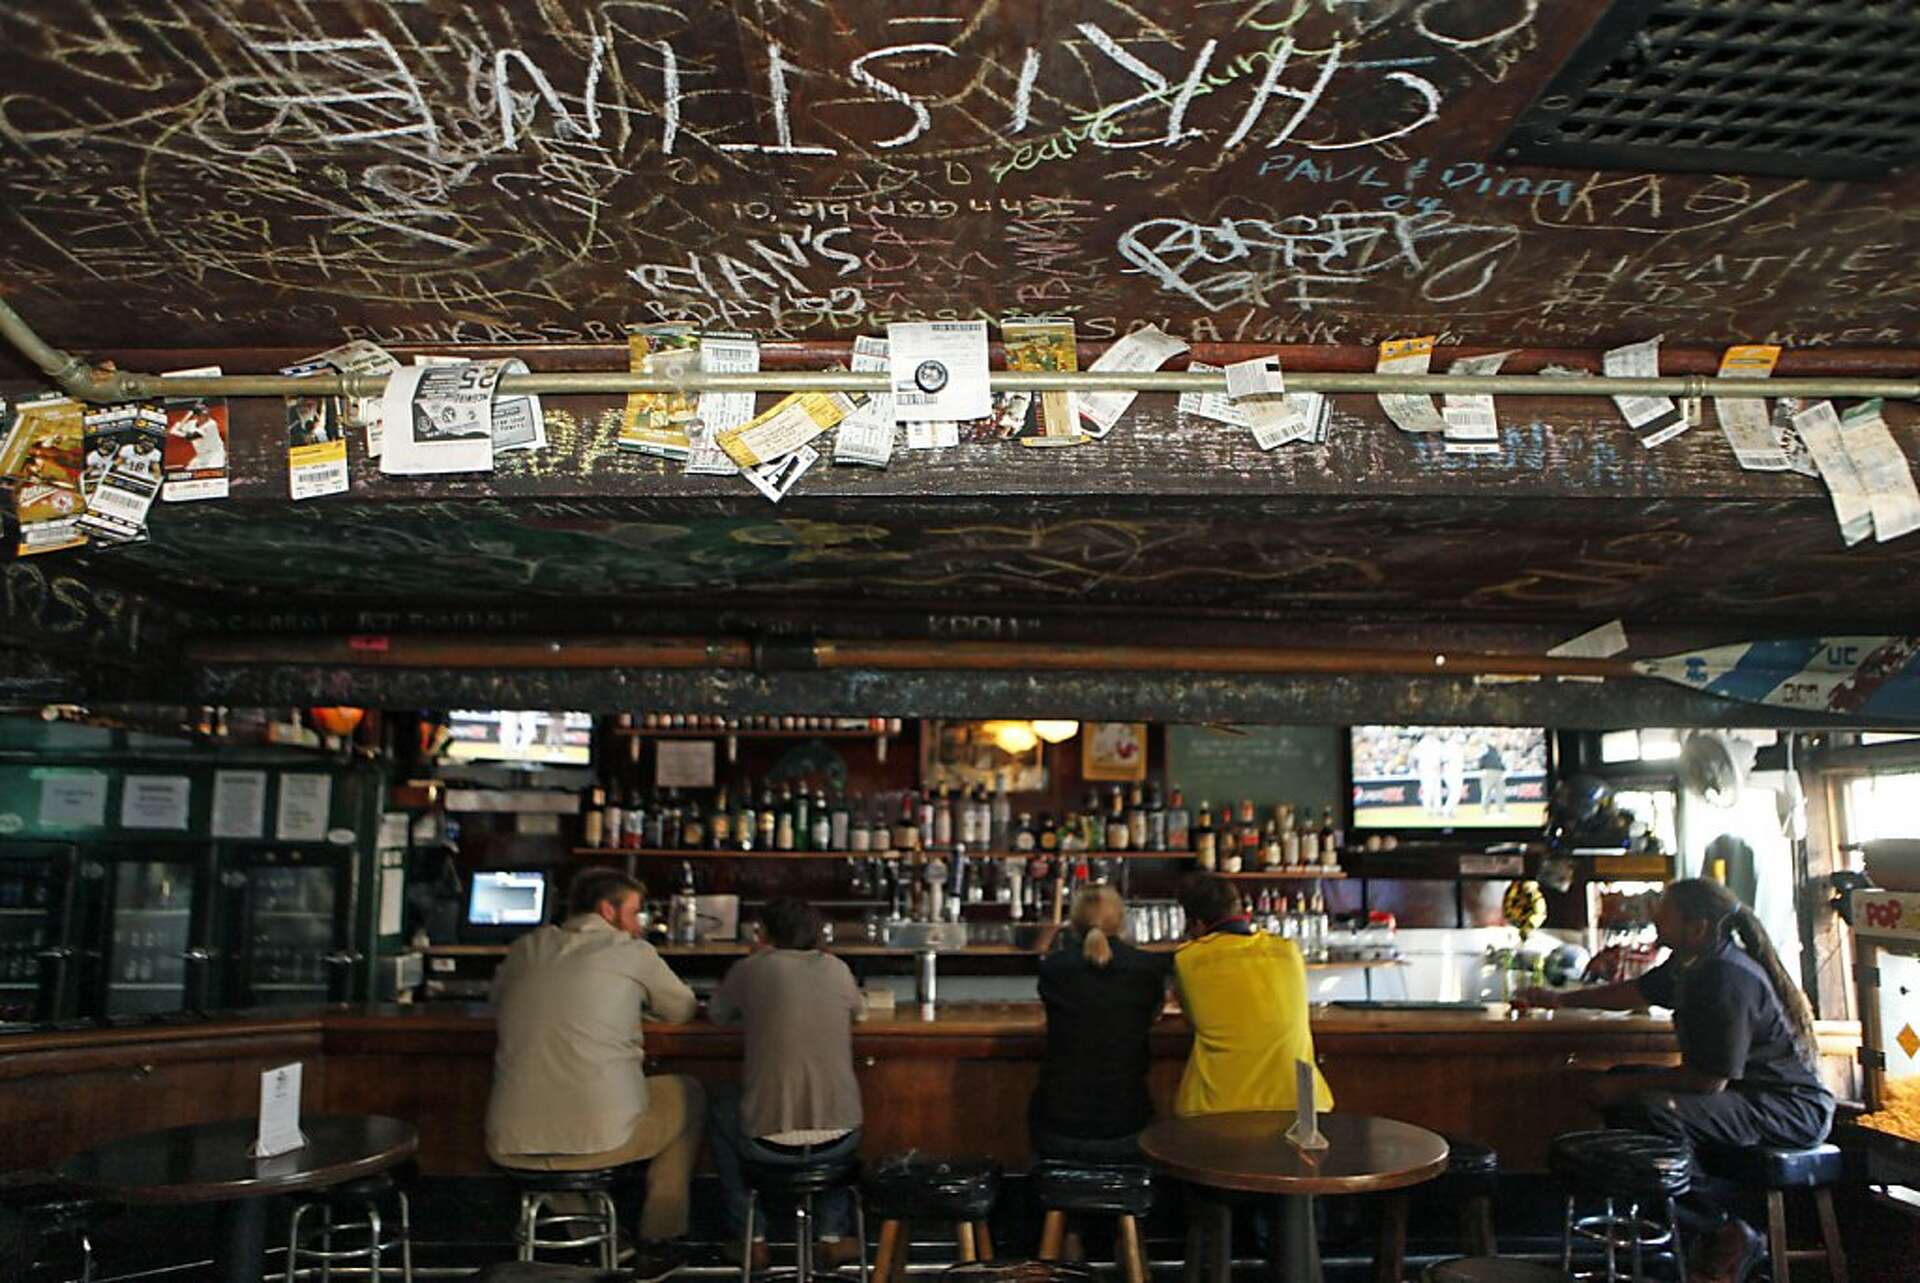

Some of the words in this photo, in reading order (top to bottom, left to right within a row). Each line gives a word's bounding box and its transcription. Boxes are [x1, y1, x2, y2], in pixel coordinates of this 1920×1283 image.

[249, 22, 1442, 162] CHRISTINE
[1257, 153, 1389, 187] PAUL
[793, 199, 959, 224] Gamble
[626, 224, 862, 301] RYAN'S
[1866, 898, 1903, 929] POP
